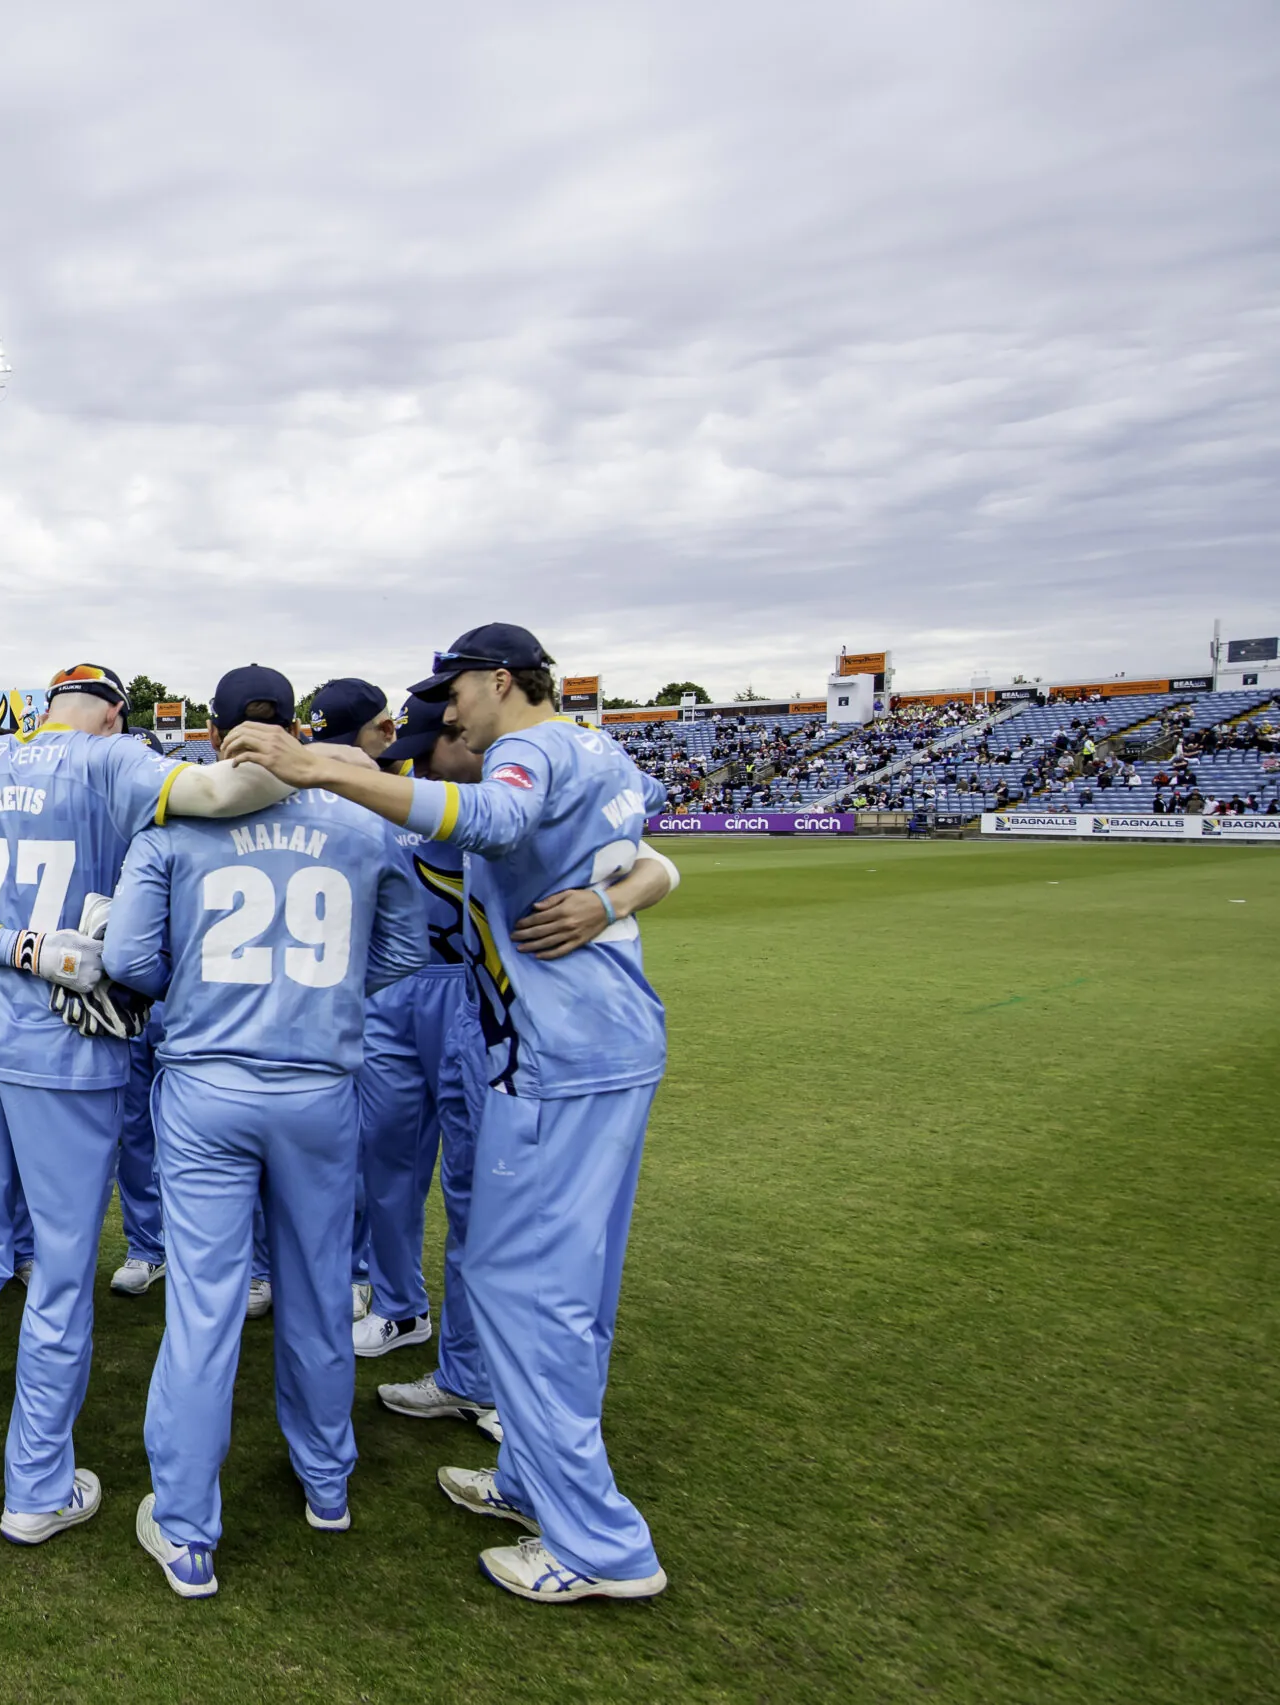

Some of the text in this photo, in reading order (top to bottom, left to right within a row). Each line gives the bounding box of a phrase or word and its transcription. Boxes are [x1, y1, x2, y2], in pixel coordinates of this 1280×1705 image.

[660, 816, 701, 830] cinch
[724, 815, 768, 830] cinch
[794, 815, 840, 830] cinch
[1012, 818, 1077, 826] BAGNALLS
[1110, 819, 1184, 827] BAGNALLS
[230, 822, 328, 859] MALAN
[202, 865, 352, 988] 29
